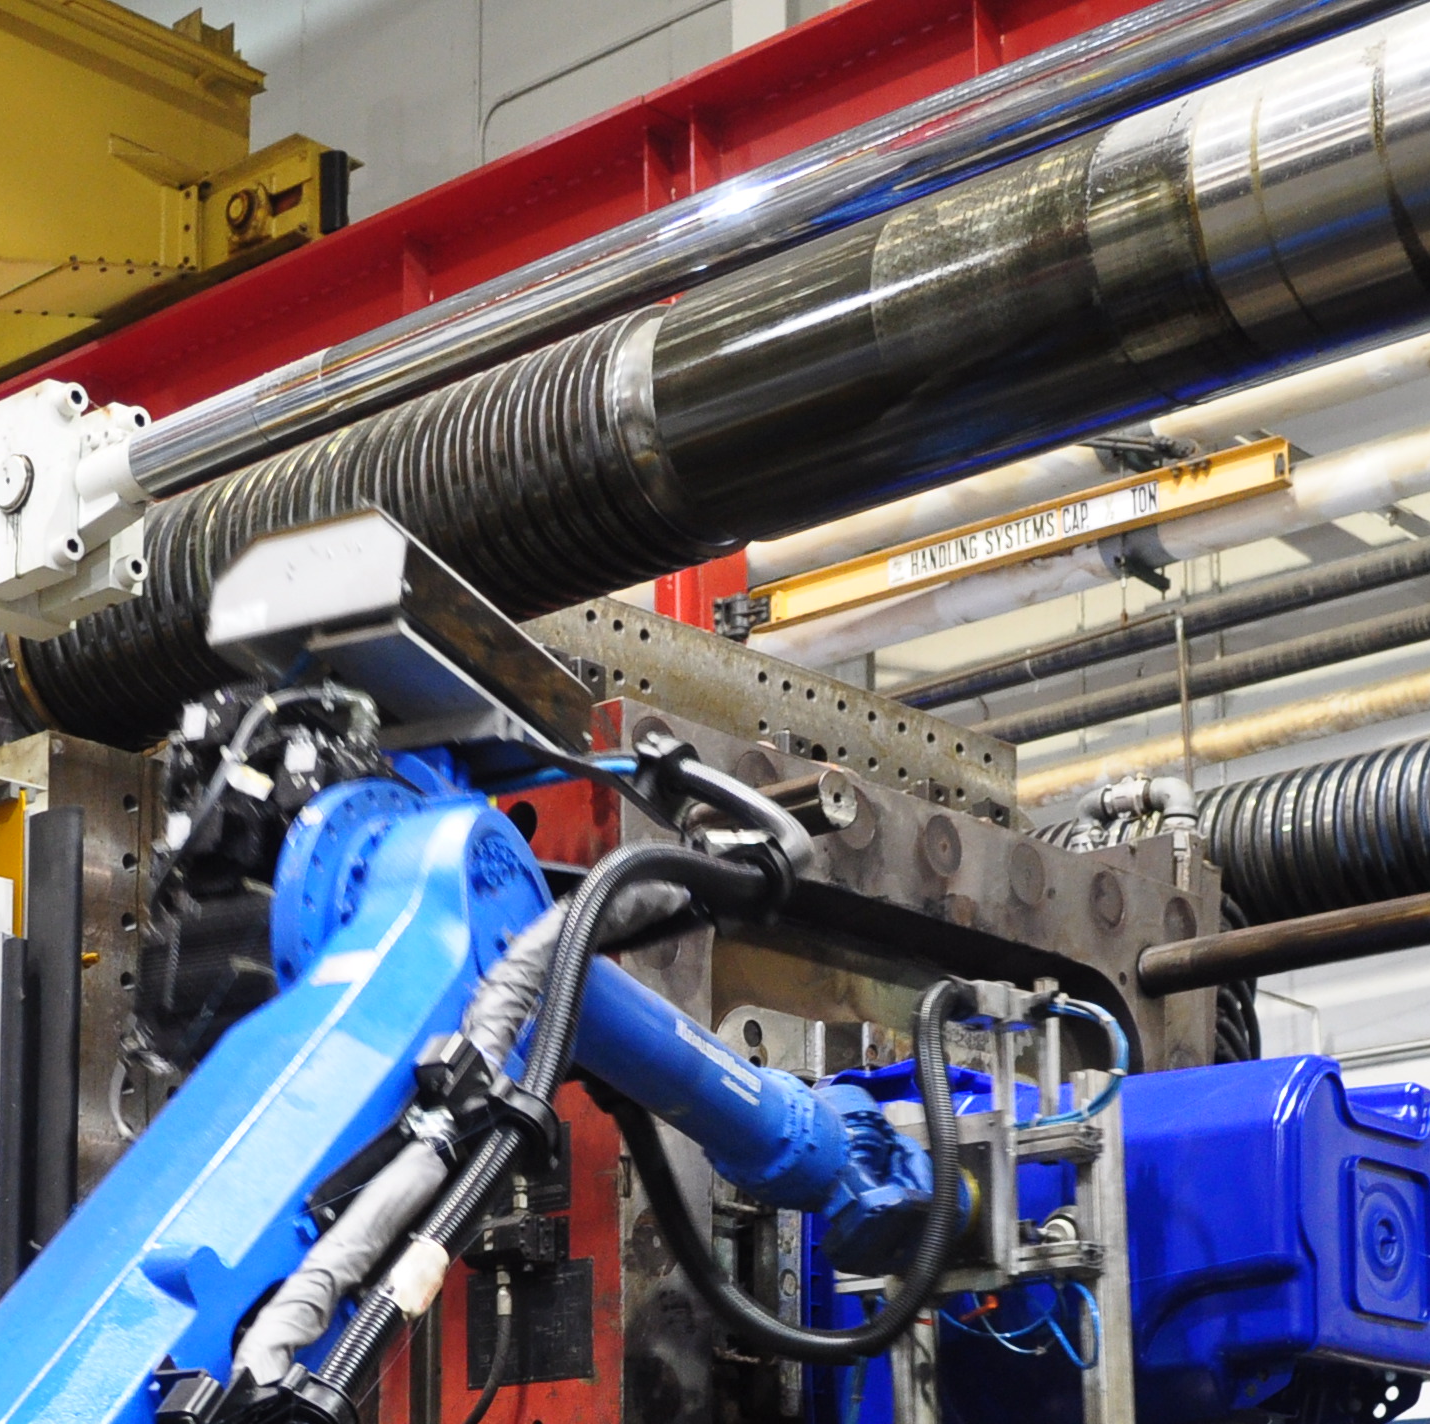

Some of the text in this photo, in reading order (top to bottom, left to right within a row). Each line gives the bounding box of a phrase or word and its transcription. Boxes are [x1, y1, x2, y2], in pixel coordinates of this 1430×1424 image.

[910, 534, 978, 577] HANDLING
[985, 513, 1056, 555] SYSTEMS
[1131, 482, 1158, 515] TON
